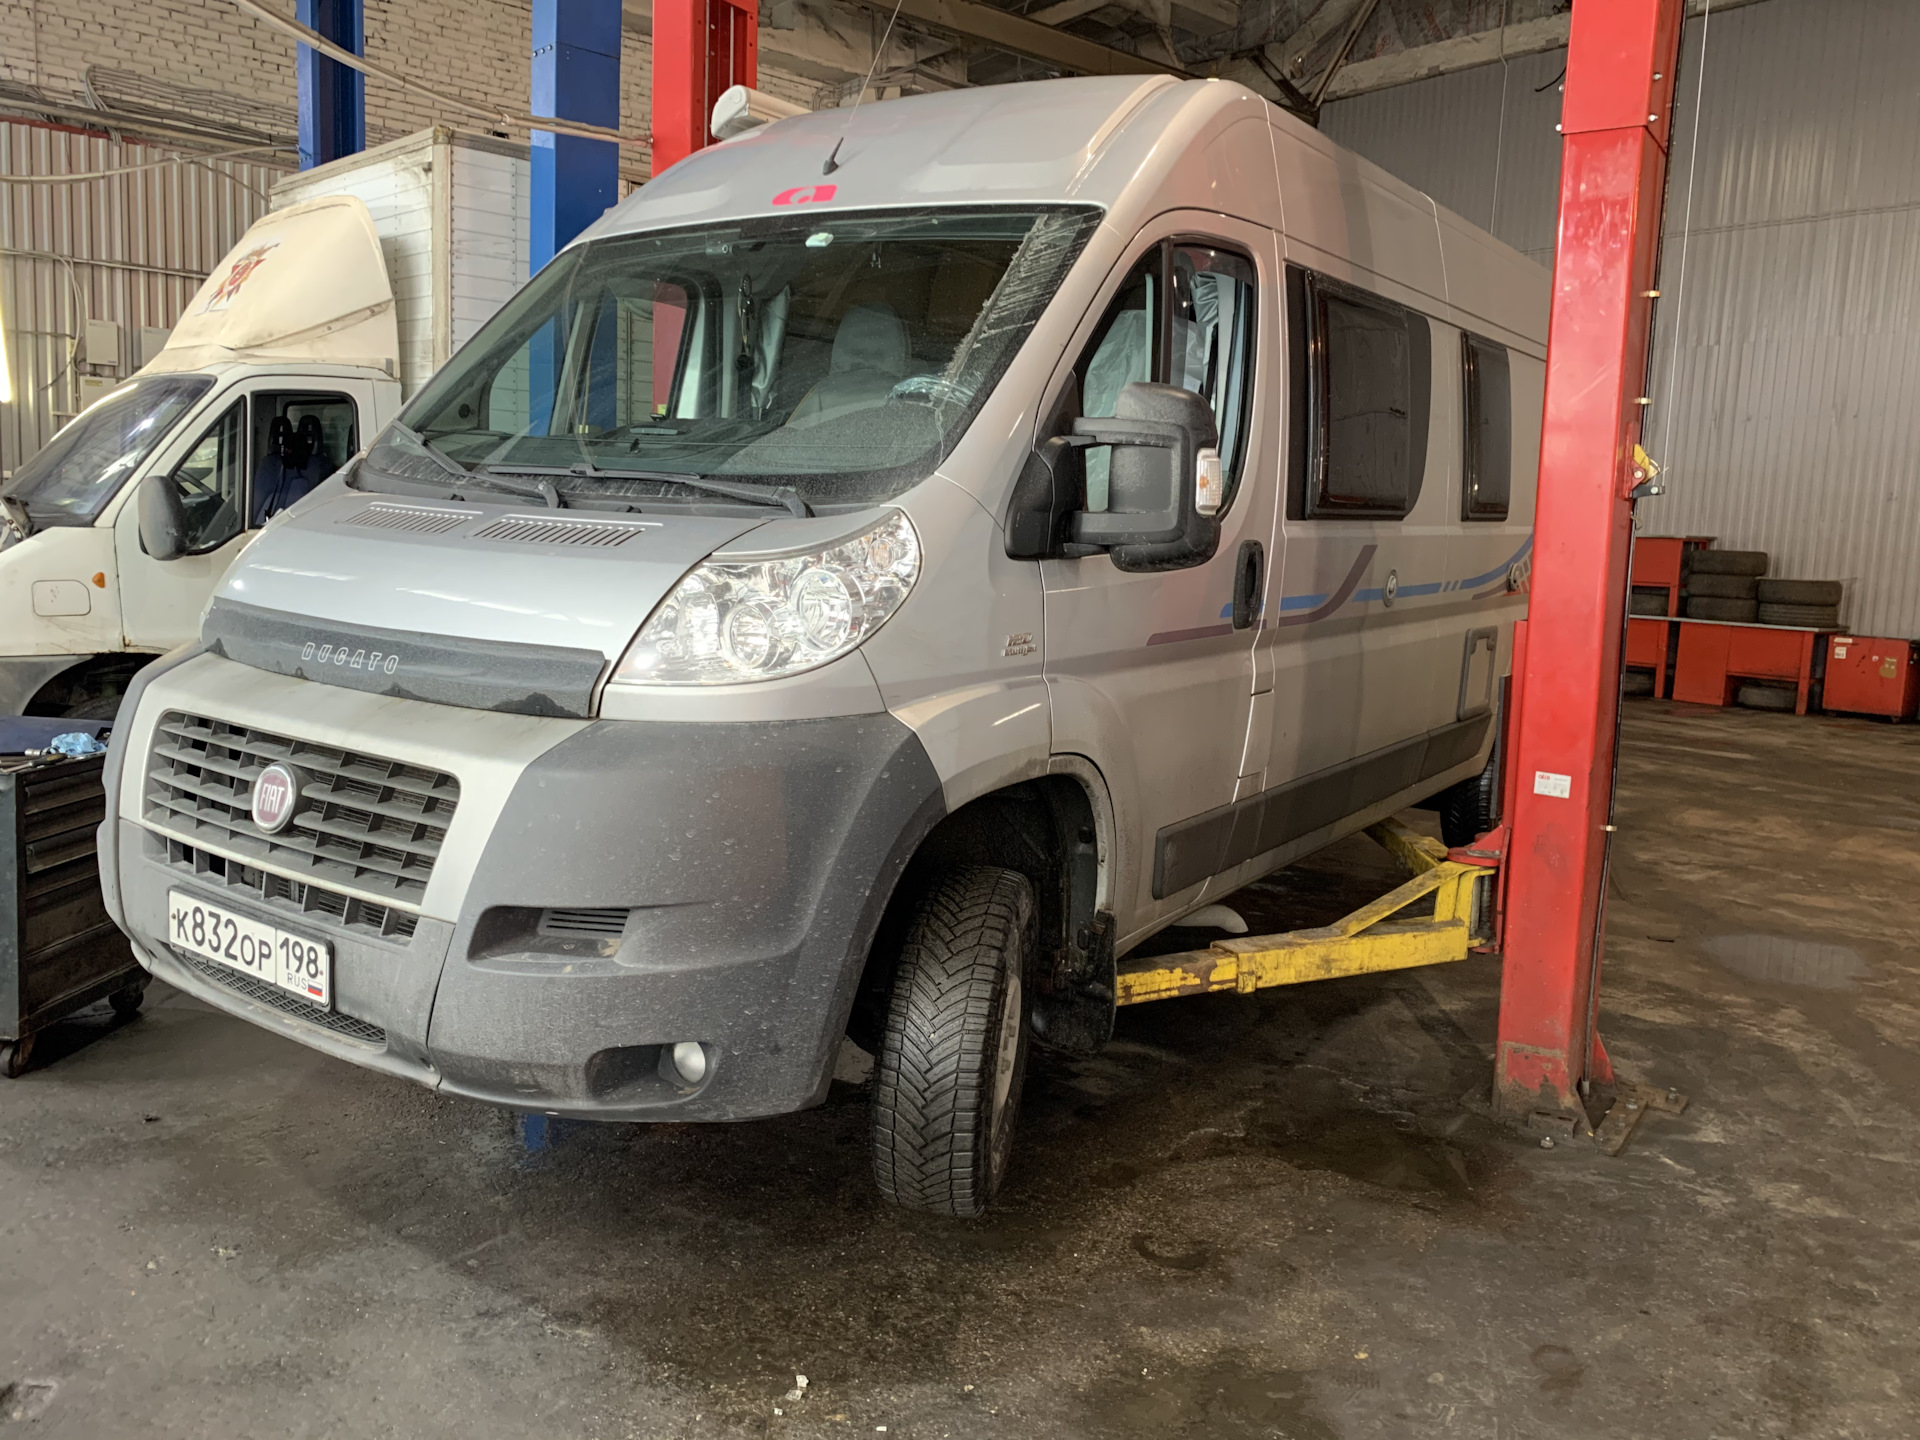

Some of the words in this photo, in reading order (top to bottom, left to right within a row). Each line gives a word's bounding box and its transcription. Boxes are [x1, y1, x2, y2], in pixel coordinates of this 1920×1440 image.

[301, 641, 399, 675] DUCATO
[259, 782, 285, 814] FIAT
[279, 937, 319, 979] 198
[287, 972, 307, 991] RUS
